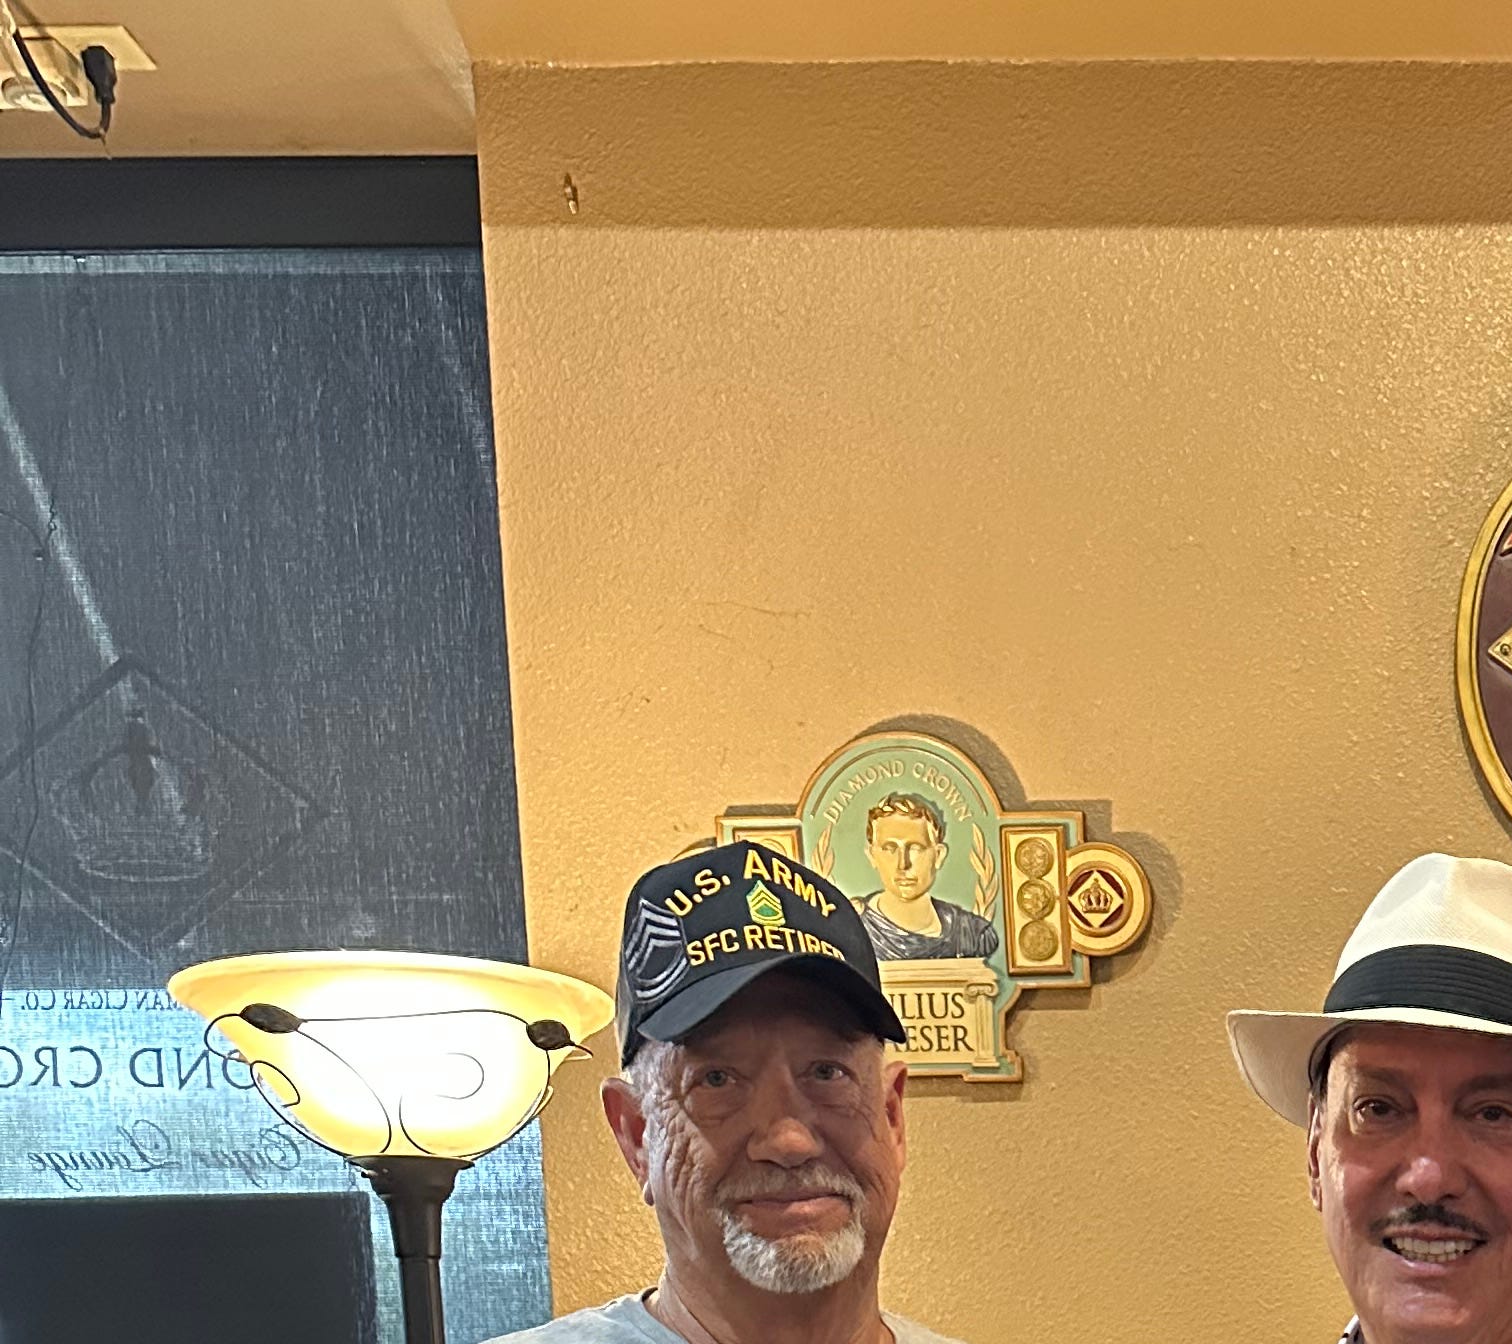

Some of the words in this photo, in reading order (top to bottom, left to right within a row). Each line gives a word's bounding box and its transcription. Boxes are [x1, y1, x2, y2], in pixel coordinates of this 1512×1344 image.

[823, 760, 904, 825] DIAMOND
[912, 762, 973, 823] CROWN
[664, 868, 731, 917] U.S.
[743, 849, 837, 918] ARMY
[686, 928, 740, 967] SFC
[743, 924, 846, 961] RETIRED
[893, 1024, 975, 1052] ESER
